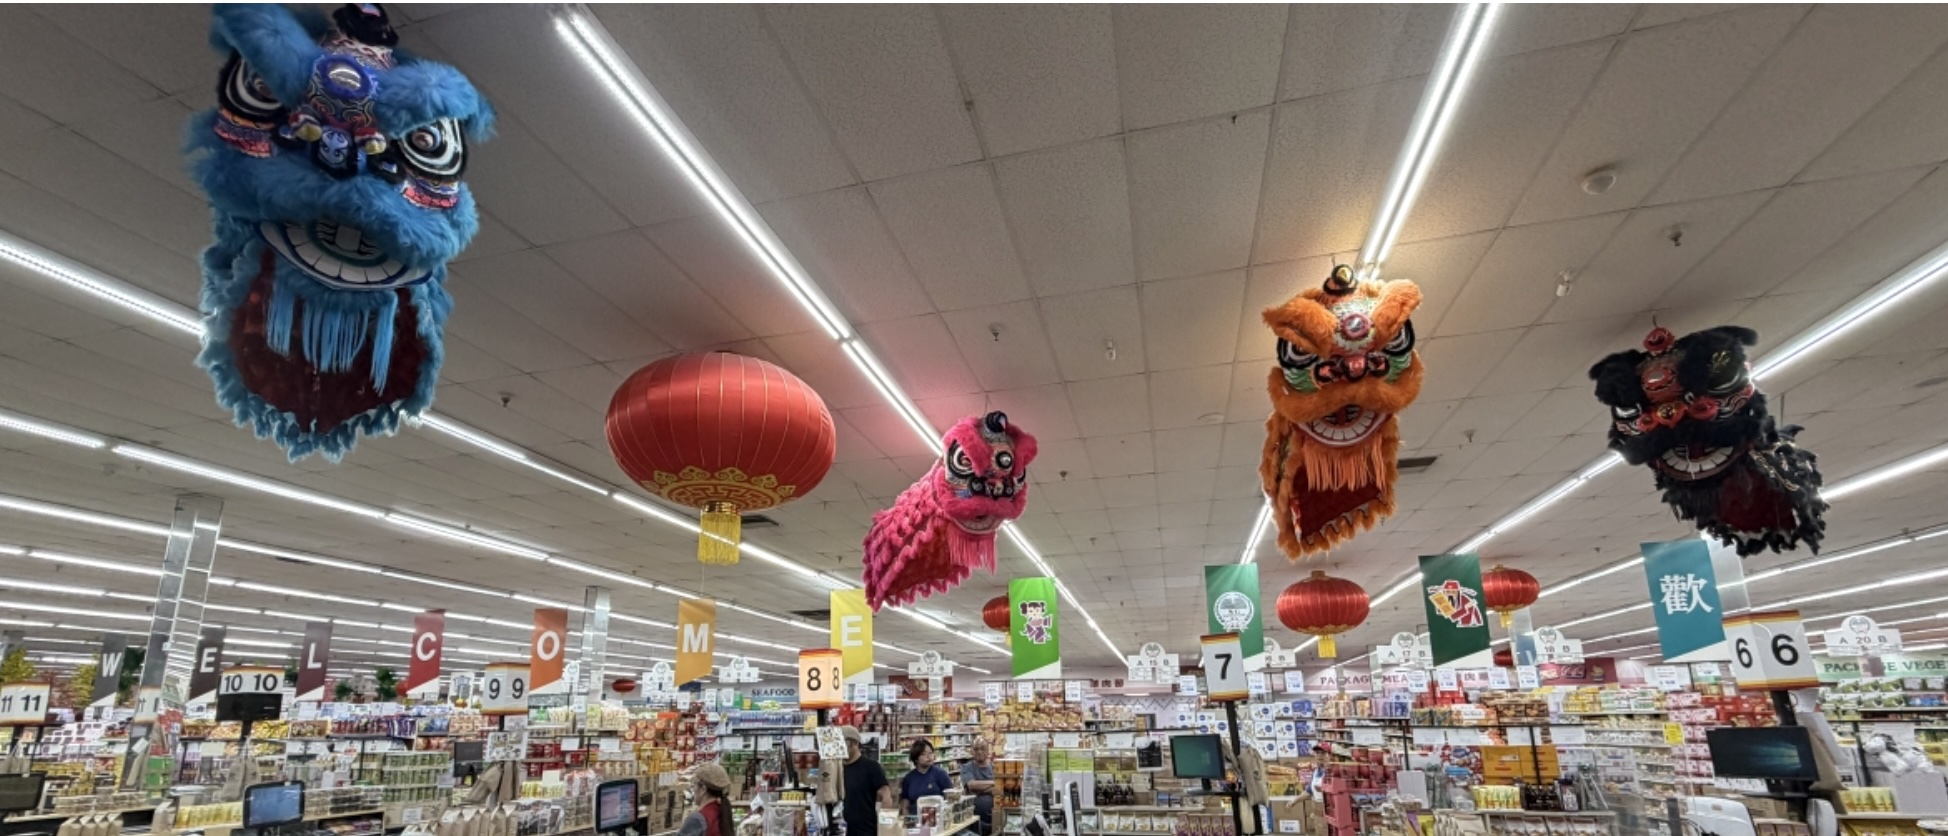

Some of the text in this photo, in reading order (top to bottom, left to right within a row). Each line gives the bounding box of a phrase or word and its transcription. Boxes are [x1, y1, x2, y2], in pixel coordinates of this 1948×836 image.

[1659, 573, 1714, 615] 歡
[682, 623, 709, 653] M
[841, 615, 863, 647] E
[1839, 635, 1887, 645] A 20 B
[307, 642, 322, 669] L
[416, 631, 437, 661] C
[536, 630, 560, 661] O
[1735, 633, 1799, 669] 6 6
[102, 652, 122, 677] W
[199, 647, 218, 673] E
[1214, 653, 1232, 680] 7
[1902, 660, 1948, 670] VEGE
[224, 673, 278, 692] 10 10
[489, 678, 524, 700] 9 9
[806, 667, 840, 691] 8 8
[1382, 674, 1409, 683] MEA
[1, 695, 41, 713] 11 11
[751, 688, 796, 696] SEAFOOD
